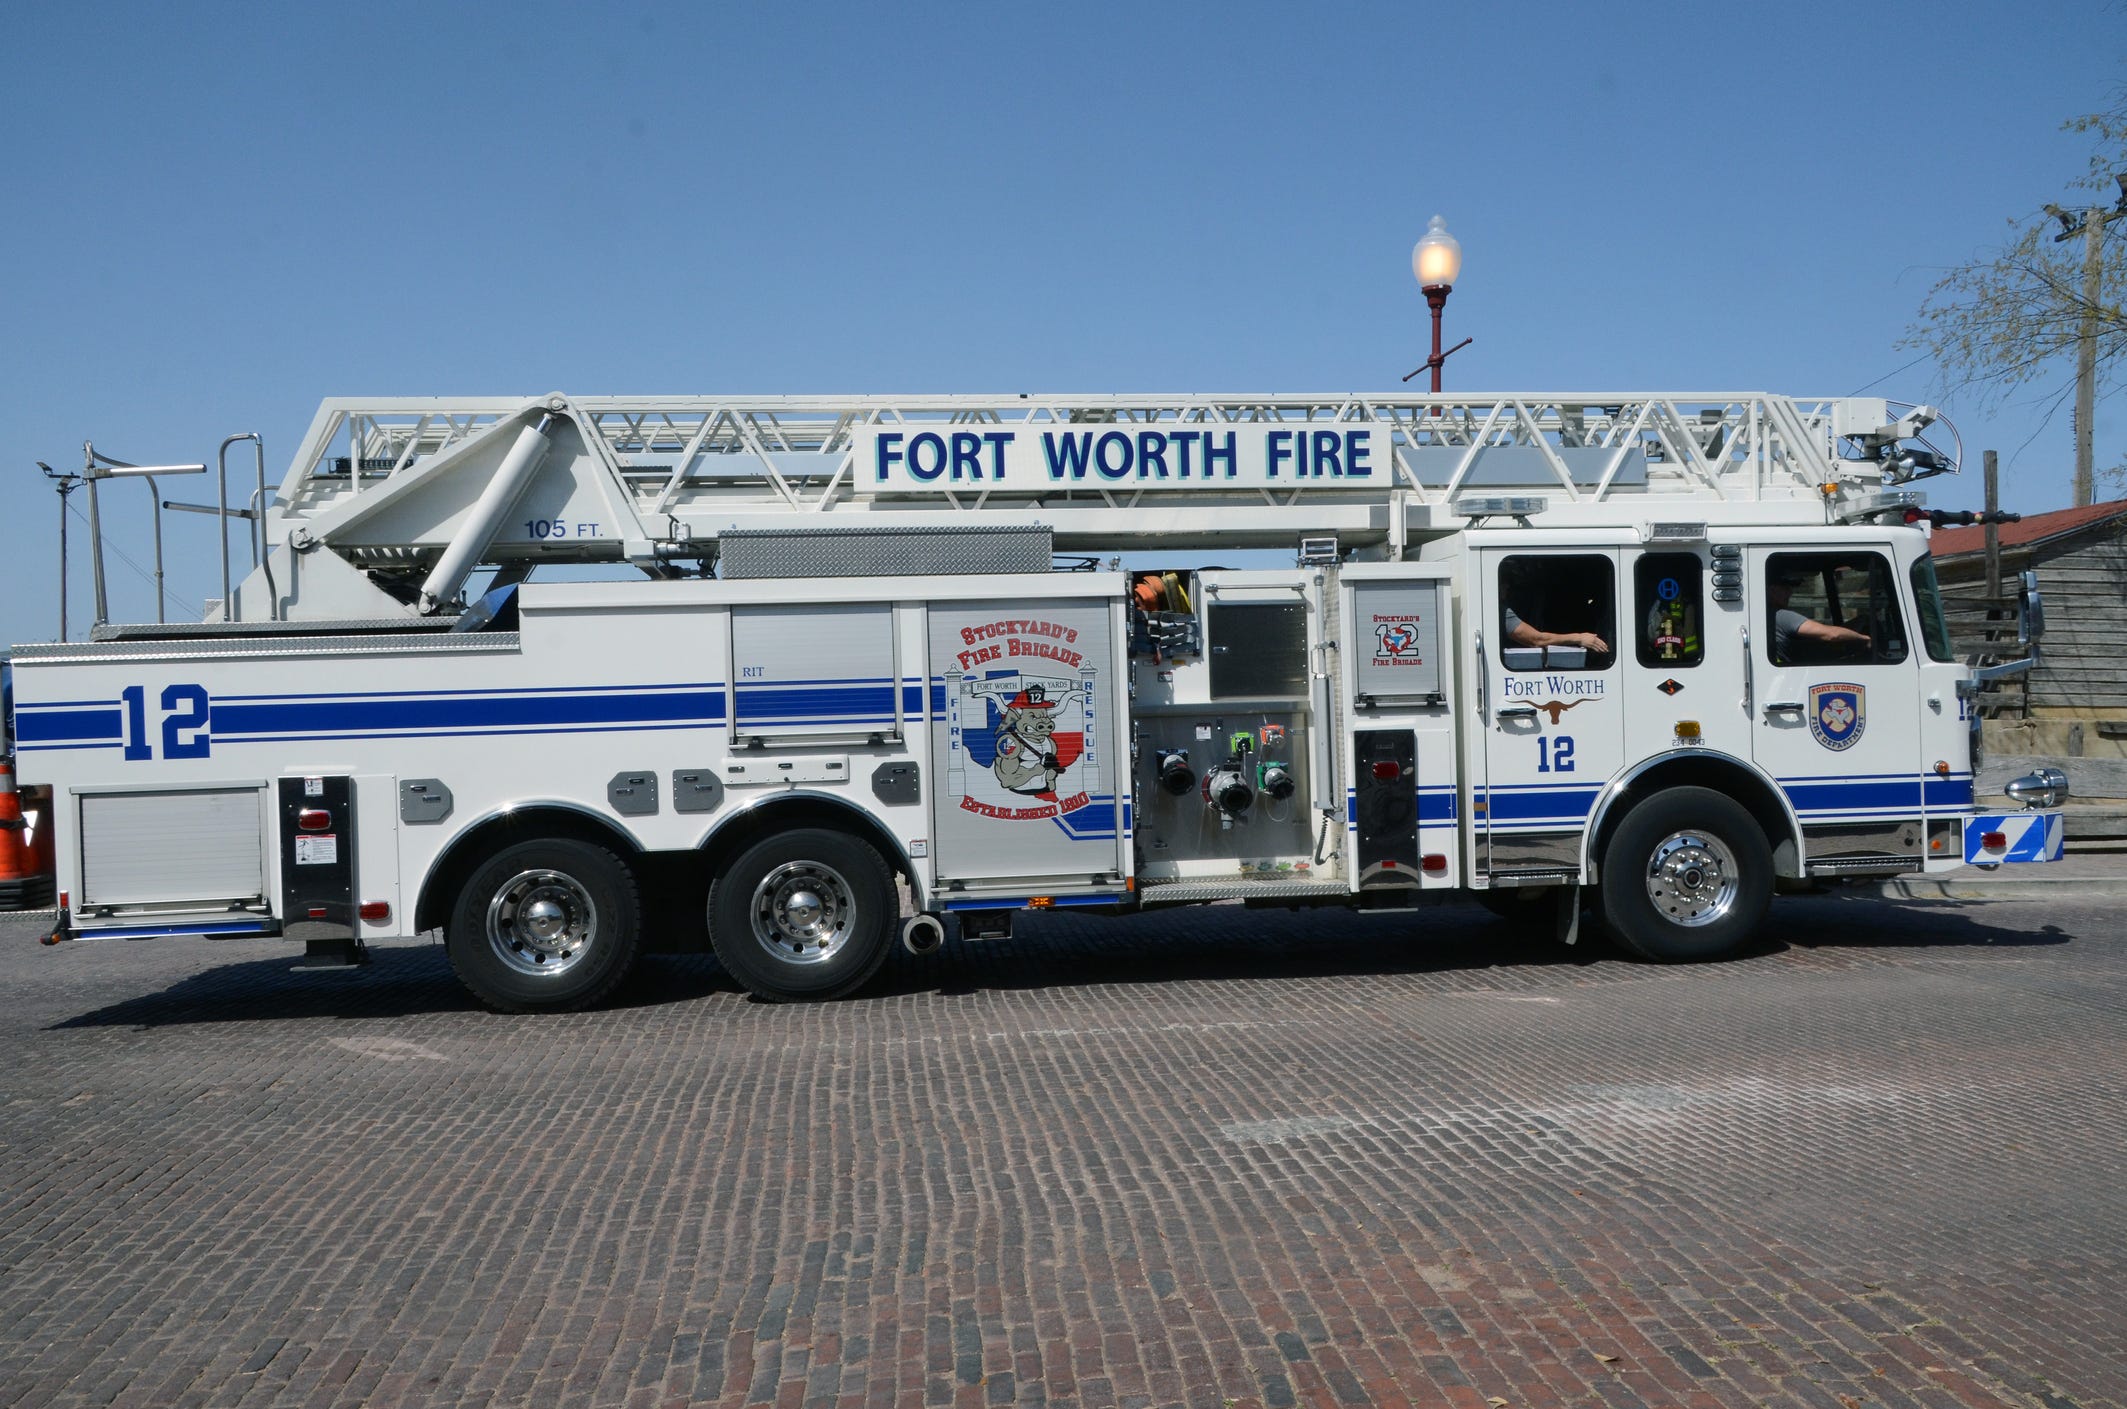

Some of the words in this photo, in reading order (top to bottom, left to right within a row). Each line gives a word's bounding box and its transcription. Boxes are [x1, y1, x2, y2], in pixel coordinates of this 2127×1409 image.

[875, 432, 1016, 483] FORT
[1040, 431, 1237, 483] WORTH
[1265, 430, 1372, 480] FIRE
[525, 519, 566, 538] 105
[577, 523, 604, 537] FT.
[960, 620, 1079, 645] STOCKYARD'S
[1375, 623, 1419, 657] 12
[957, 644, 1002, 671] FIRE
[1007, 638, 1083, 668] BRIGADE
[1372, 658, 1390, 666] FIRE
[1392, 657, 1423, 666] BRIGADE
[743, 666, 765, 677] RIT
[976, 682, 992, 691] FORT
[995, 682, 1018, 691] WORTH
[1047, 681, 1068, 689] YARDS
[1030, 693, 1042, 704] 12
[1504, 677, 1543, 696] FORT
[1546, 676, 1605, 695] WORTH
[1812, 685, 1832, 695] FORT
[1833, 684, 1863, 694] WORTH
[122, 684, 210, 761] 12
[950, 698, 961, 750] FIRE
[1085, 681, 1096, 762] RESCUE
[1812, 716, 1823, 738] FIRE
[1821, 715, 1864, 749] DEPARTMENT
[1537, 735, 1575, 772] 12
[960, 794, 1058, 820] ESTABLISHED
